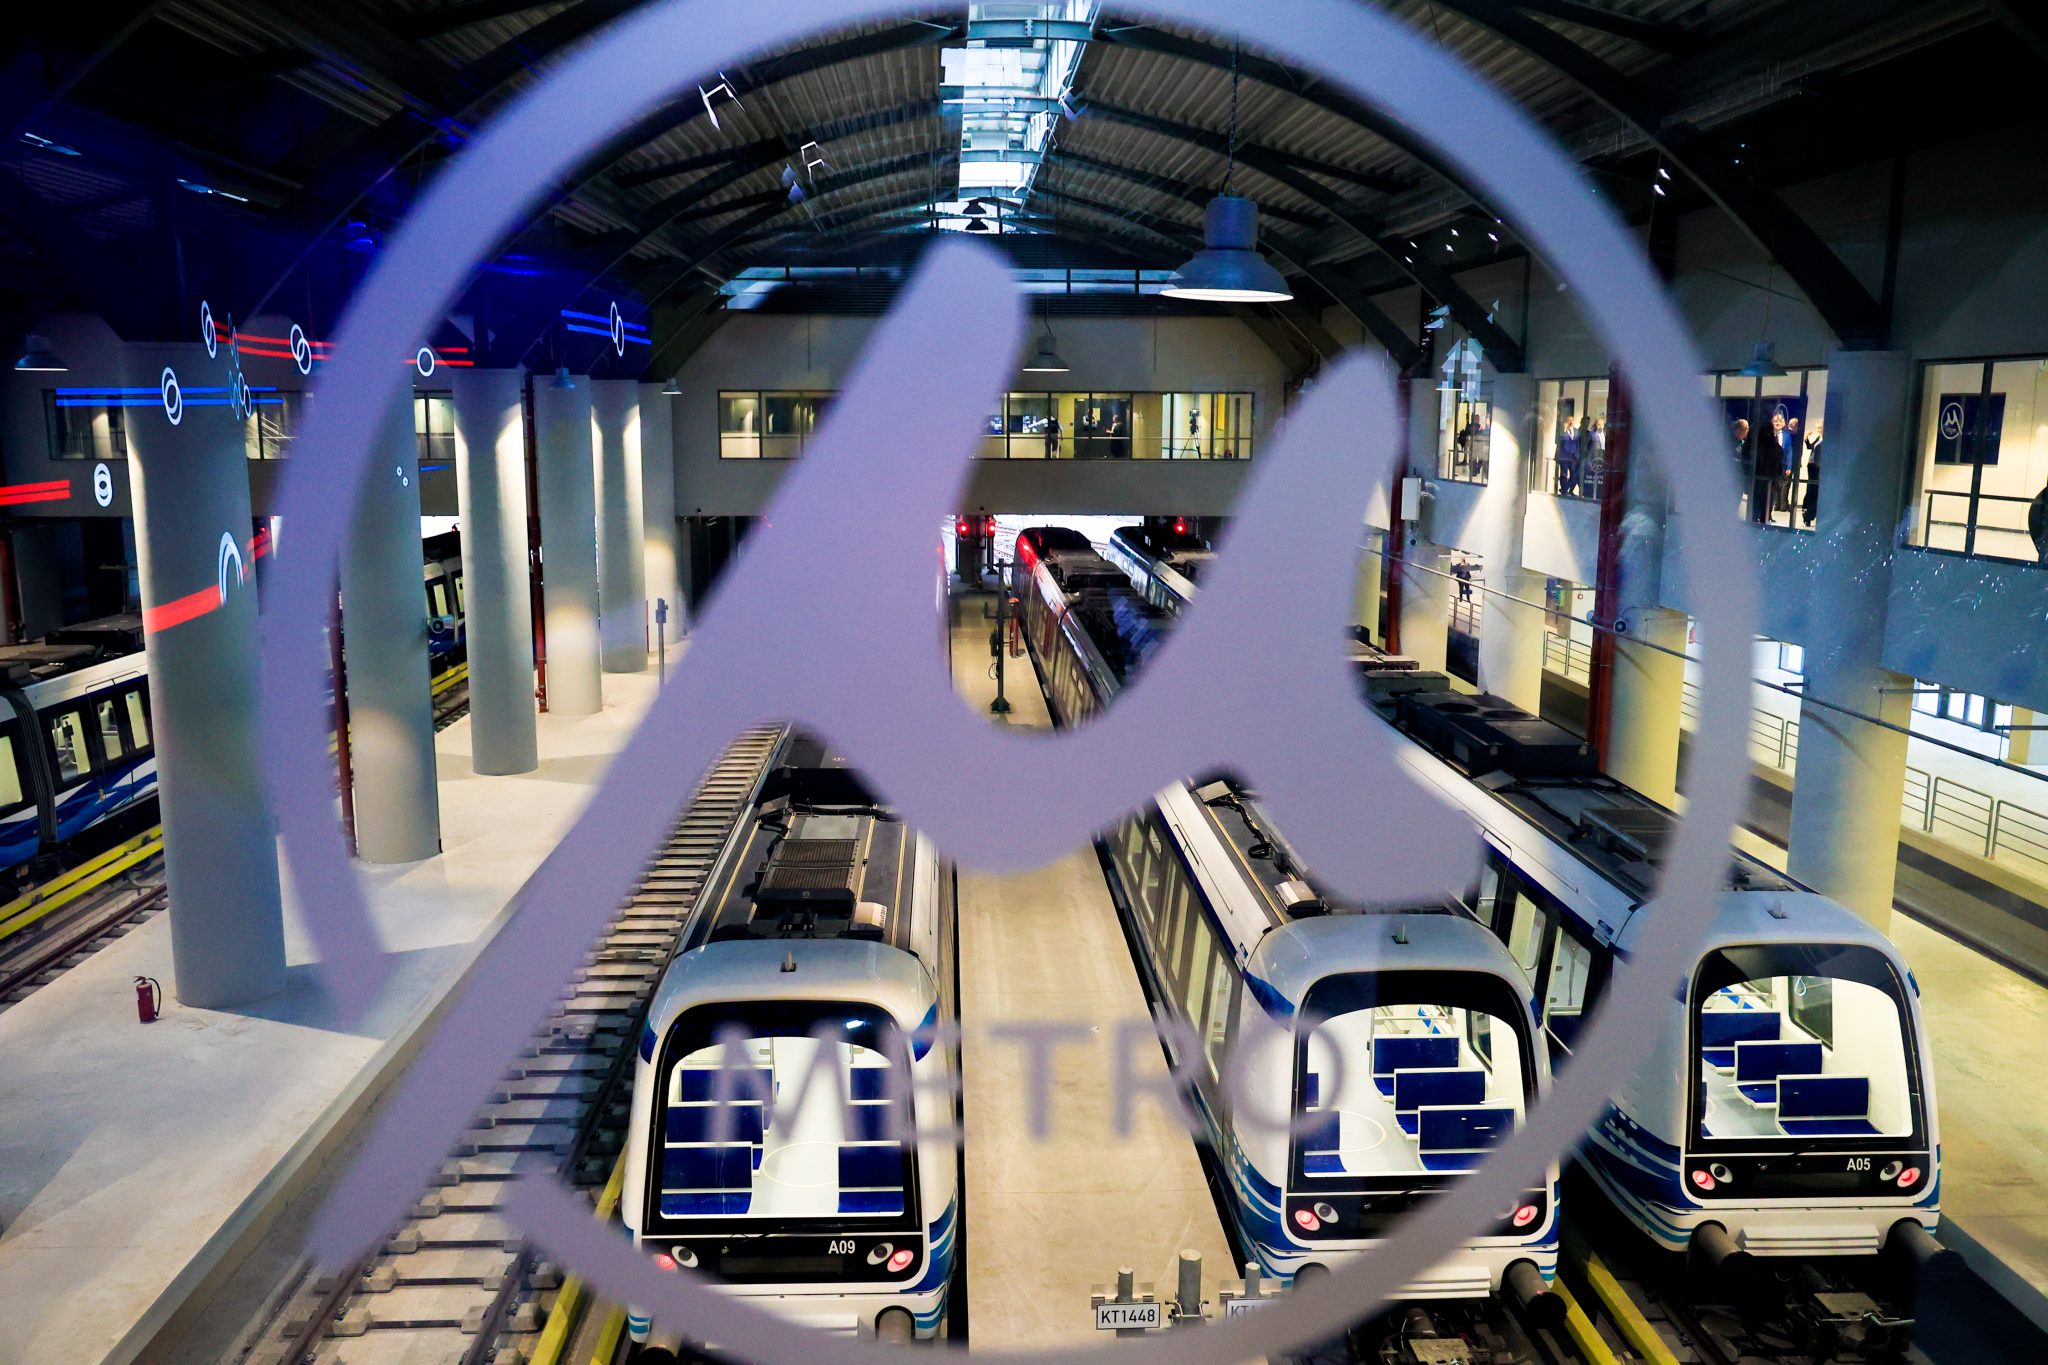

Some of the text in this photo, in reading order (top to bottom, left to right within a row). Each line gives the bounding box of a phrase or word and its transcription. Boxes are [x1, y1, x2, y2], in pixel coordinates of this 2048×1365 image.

[703, 1018, 1345, 1143] METRO
[1847, 1157, 1871, 1171] A05
[828, 1240, 856, 1254] A09
[1101, 1309, 1155, 1324] KT1448
